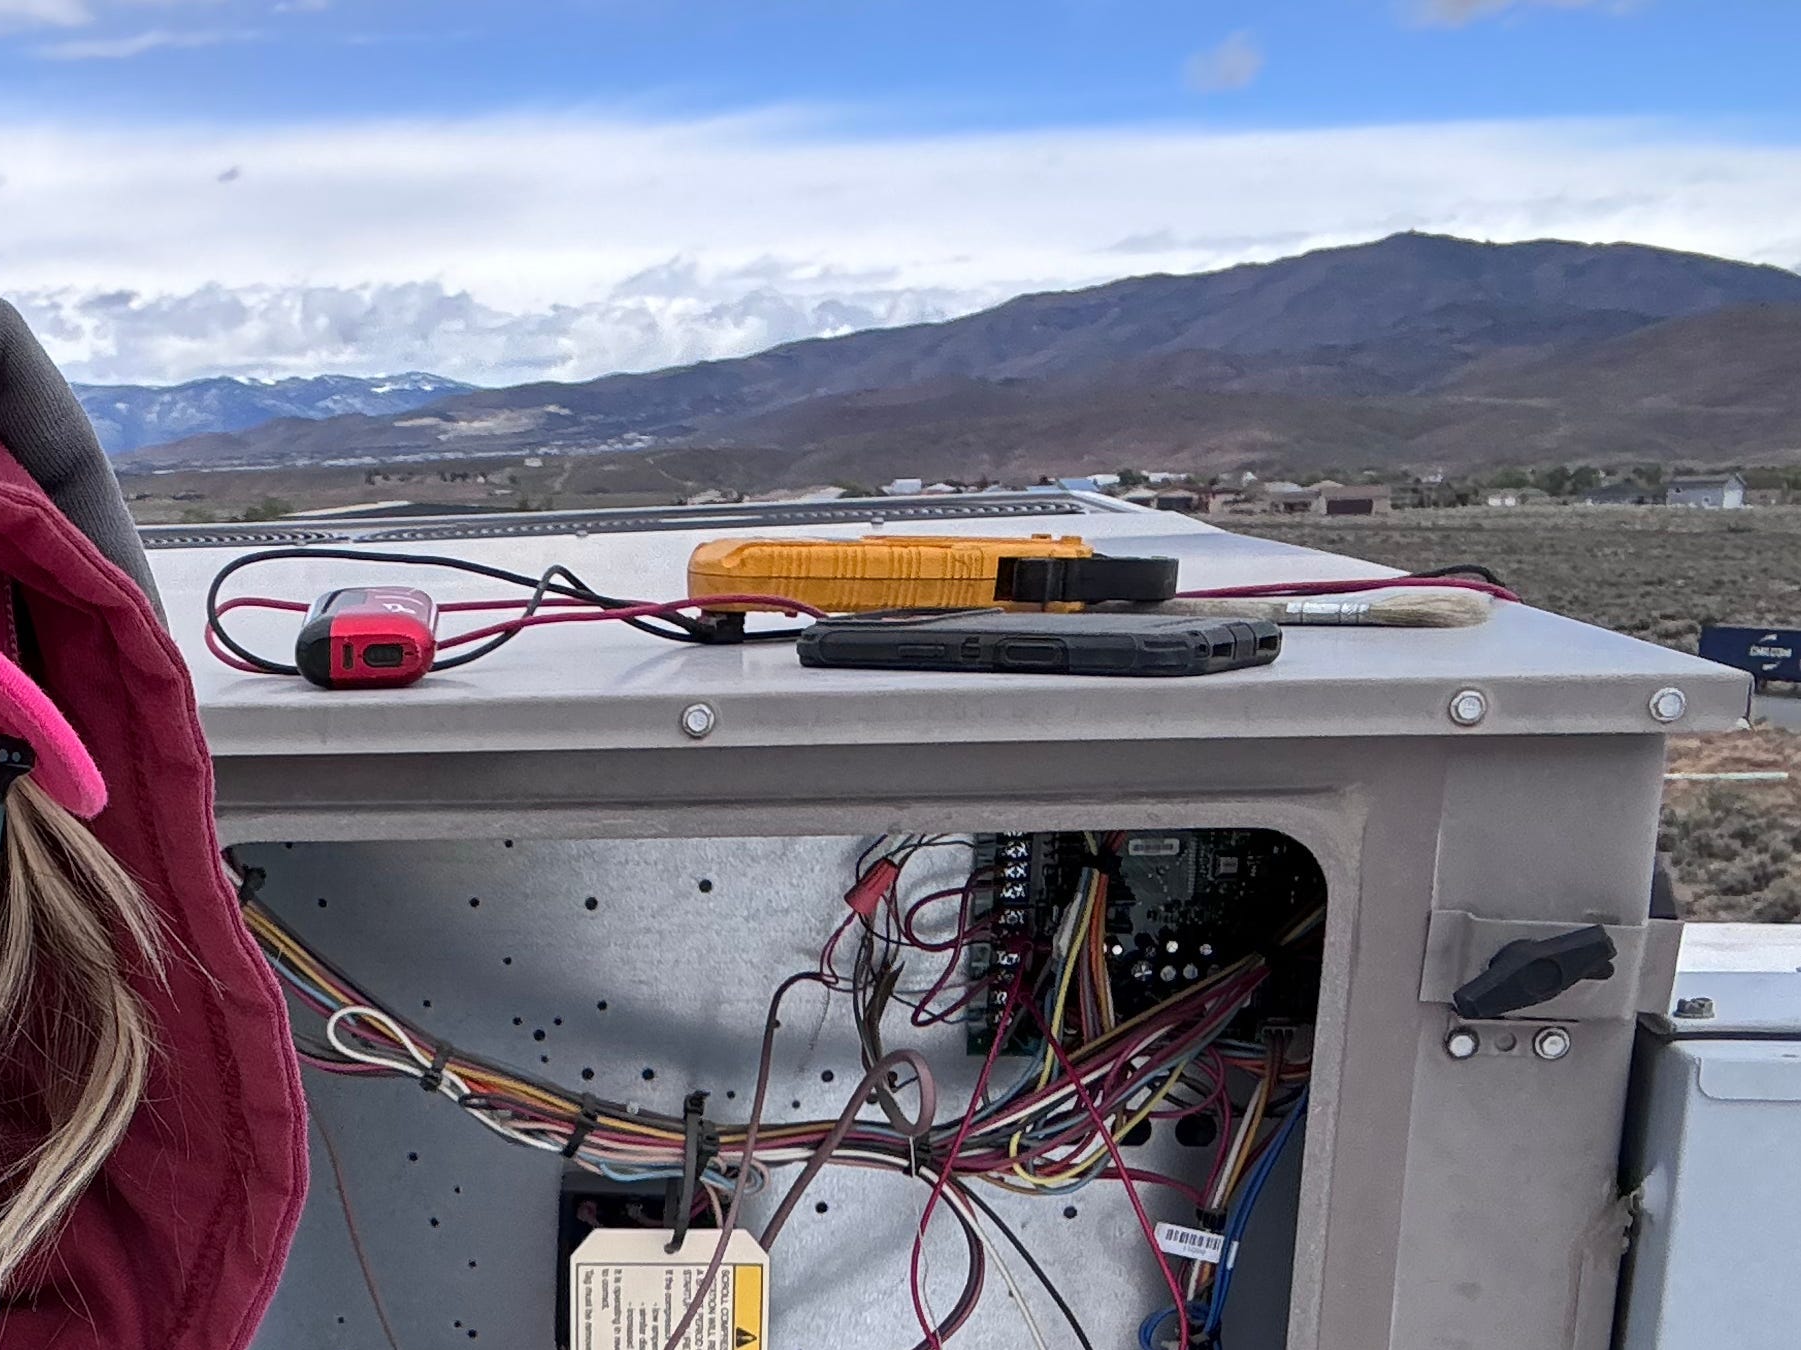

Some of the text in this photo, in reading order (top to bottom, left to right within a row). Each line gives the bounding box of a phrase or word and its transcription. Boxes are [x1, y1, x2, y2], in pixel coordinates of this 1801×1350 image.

[721, 1269, 730, 1304] SCROLL
[695, 1313, 703, 1345] PERIOD
[707, 1317, 715, 1336] WILL
